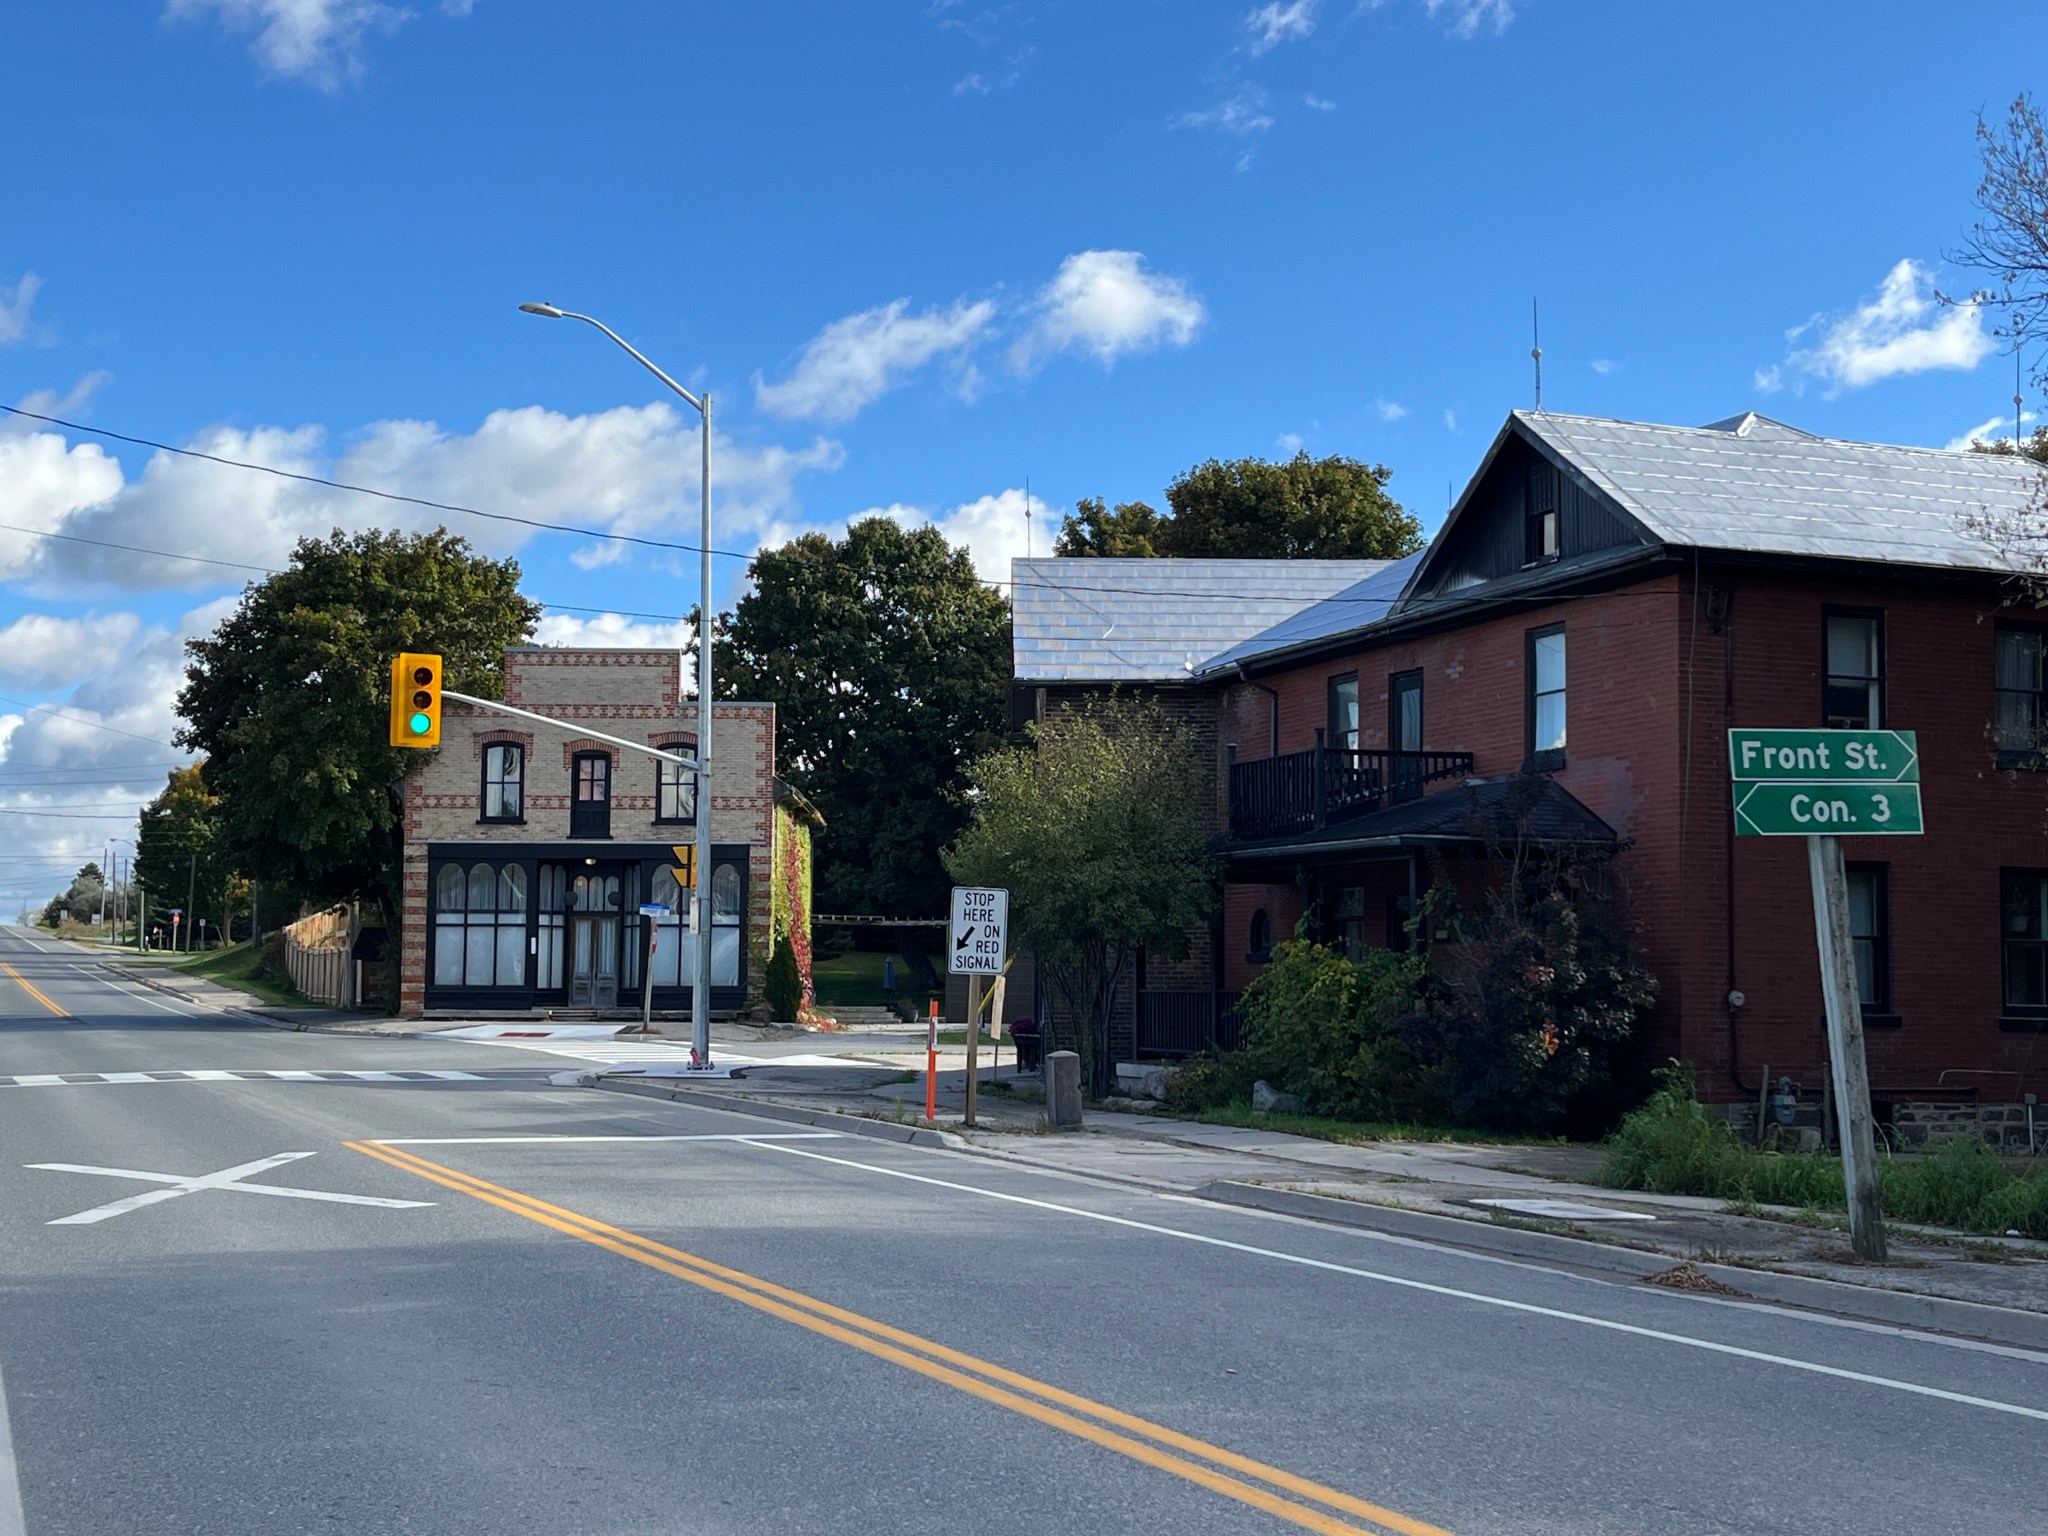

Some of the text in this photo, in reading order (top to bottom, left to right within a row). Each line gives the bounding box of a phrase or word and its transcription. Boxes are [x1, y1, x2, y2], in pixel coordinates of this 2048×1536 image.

[1741, 740, 1887, 770] Front St.
[1790, 794, 1891, 823] Con. 3
[964, 892, 995, 907] STOP
[963, 908, 995, 922] HERE
[984, 925, 1000, 939] ON
[976, 941, 999, 954] RED
[955, 955, 998, 970] SIGNAL
